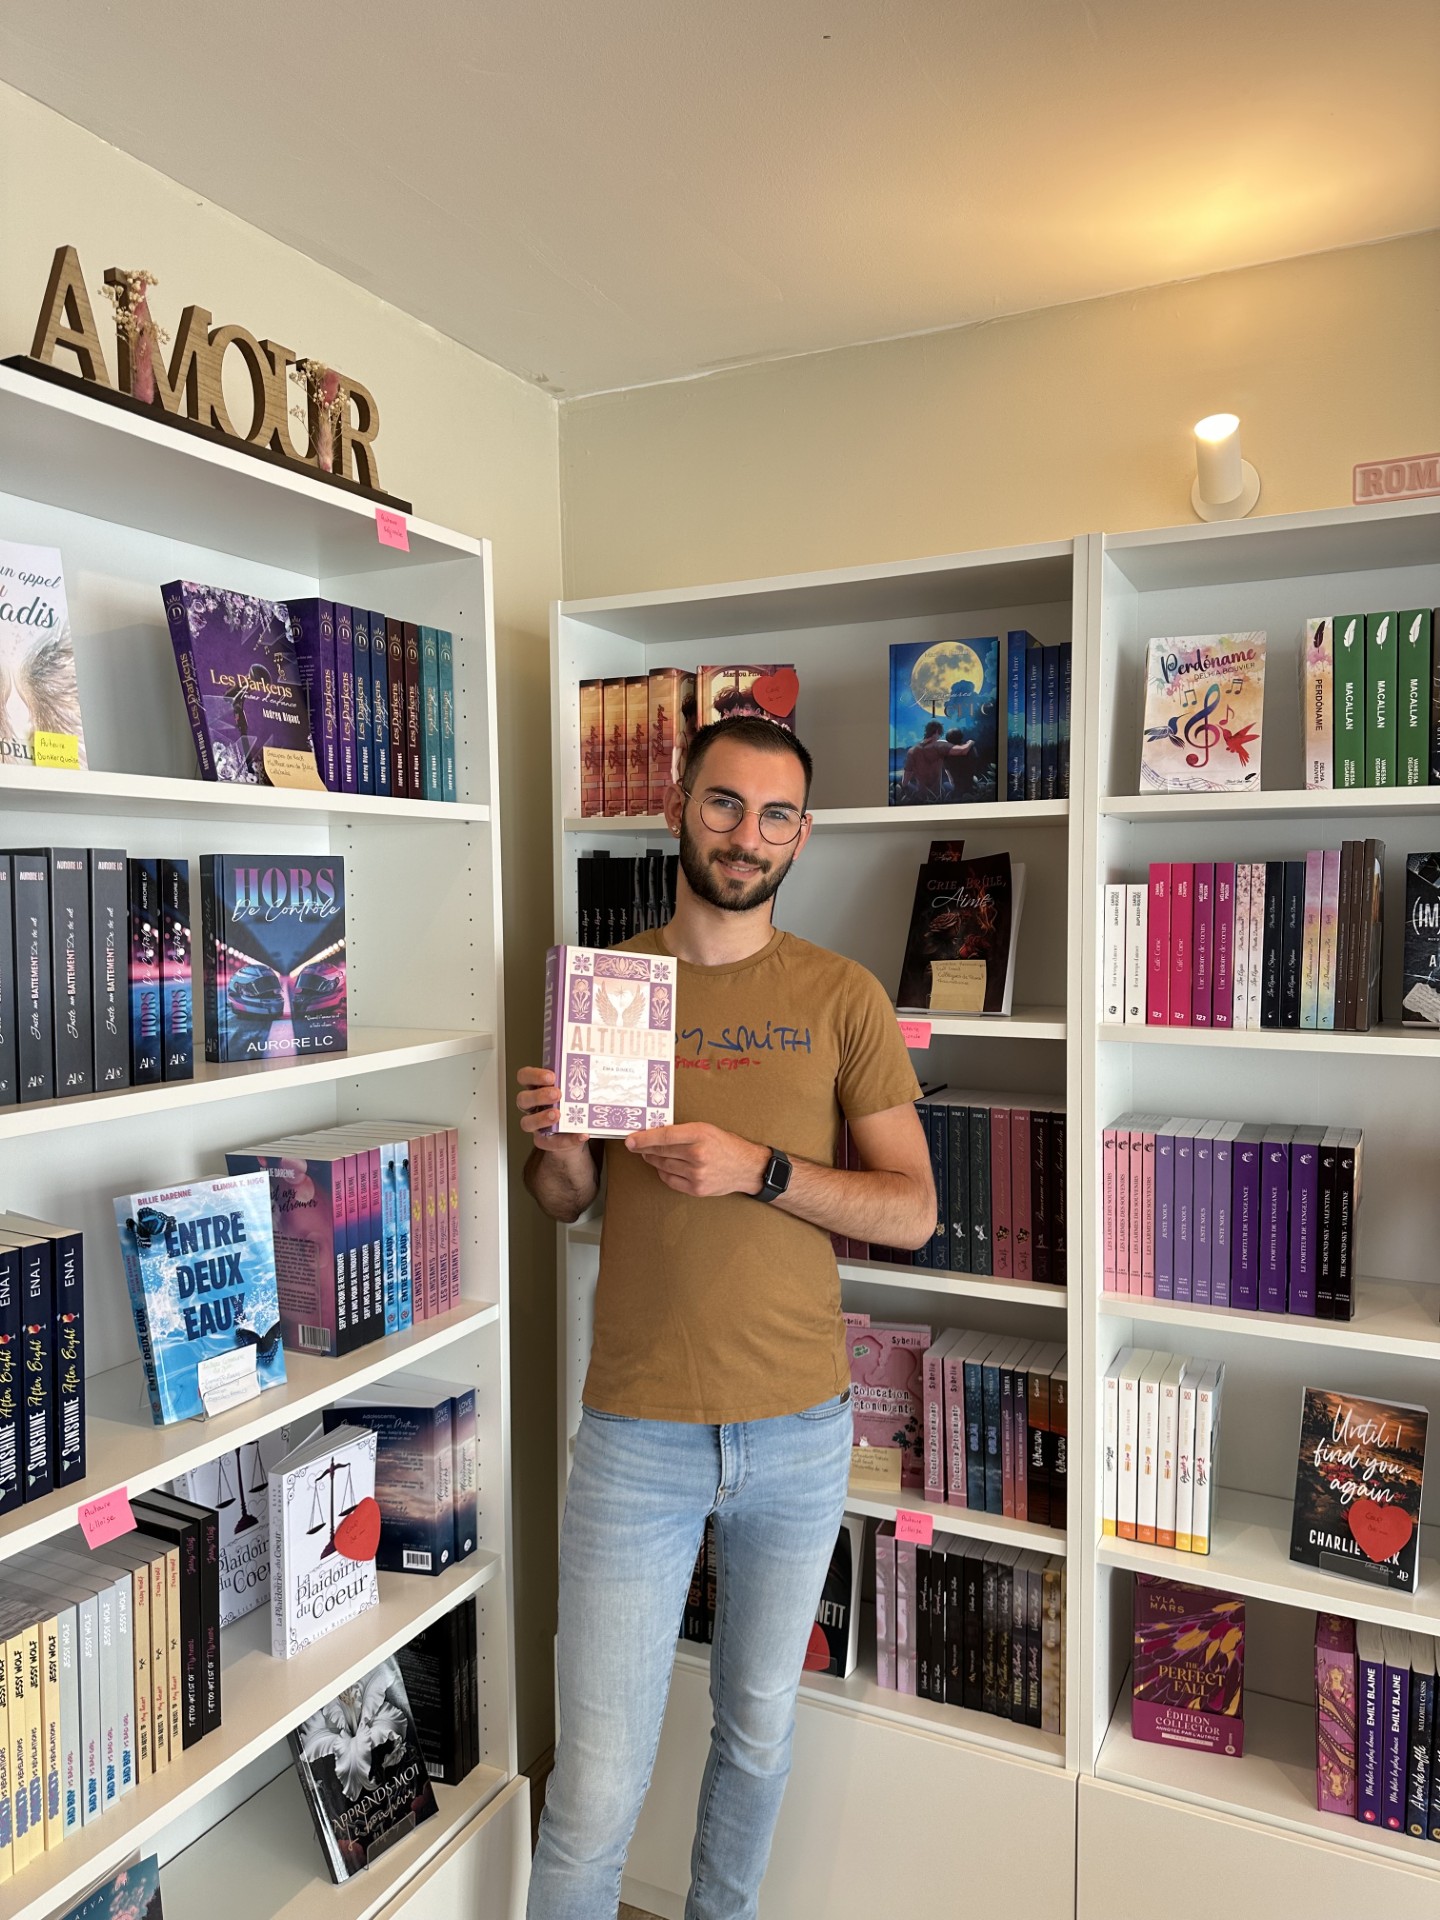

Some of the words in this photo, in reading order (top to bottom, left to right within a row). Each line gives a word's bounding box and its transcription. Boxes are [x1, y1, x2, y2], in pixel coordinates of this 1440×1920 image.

[29, 245, 388, 494] AMOUR
[18, 569, 61, 589] appel
[1160, 648, 1257, 684] Perdóname
[1222, 662, 1256, 676] BOUVIER
[210, 669, 236, 687] Les
[237, 674, 293, 698] Darkens
[1314, 679, 1323, 731] PERDÓNAME
[1345, 682, 1353, 730] MACALLAN
[1377, 680, 1385, 728] MACALLAN
[38, 871, 44, 881] LC
[142, 872, 147, 880] LC
[234, 867, 335, 908] HORS
[231, 898, 260, 922] De
[265, 898, 341, 923] Contrôle
[1153, 957, 1161, 971] Café
[1197, 954, 1206, 975] histoire
[30, 1012, 41, 1040] Juste
[141, 991, 156, 1037] HORS
[570, 1025, 668, 1059] ALTITUDE
[137, 1195, 159, 1206] BILLIE
[160, 1189, 192, 1202] DARENNE
[164, 1210, 246, 1259] ENTRE
[1242, 1223, 1248, 1231] DE
[64, 1248, 74, 1259] L
[386, 1236, 394, 1256] EAUX
[64, 1262, 75, 1287] ENA
[176, 1252, 244, 1299] DEUX
[1242, 1261, 1247, 1269] LE
[1270, 1262, 1276, 1270] LE
[414, 1262, 422, 1296] INSTANTS
[0, 1278, 11, 1306] ENA
[136, 1308, 148, 1333] EAUX
[183, 1293, 246, 1341] EAUX
[338, 1316, 346, 1330] SEPT
[60, 1328, 77, 1359] Eight
[140, 1335, 152, 1360] DEUX
[892, 1336, 920, 1346] Sybelia
[62, 1364, 77, 1393] After
[146, 1361, 156, 1392] ENTRE
[458, 1398, 473, 1410] LOVE
[853, 1385, 909, 1400] Colocation
[1331, 1405, 1389, 1449] Until
[1312, 1437, 1360, 1470] find
[1328, 1475, 1395, 1505] again
[274, 1531, 282, 1558] Coeur
[1309, 1529, 1360, 1555] CHARLIE
[297, 1574, 310, 1588] La
[297, 1560, 364, 1606] Plaidoirie
[274, 1573, 283, 1617] Plaidoirie
[297, 1603, 310, 1618] du
[312, 1574, 368, 1619] Coeur
[1150, 1595, 1175, 1604] LYLA
[1150, 1603, 1185, 1614] MARS
[14, 1650, 23, 1673] WOLF
[29, 1640, 37, 1663] WOLF
[30, 1666, 38, 1688] JESSY
[1158, 1664, 1226, 1687] PERFECT
[1185, 1662, 1199, 1670] THE
[15, 1676, 24, 1698] JESSY
[1174, 1680, 1209, 1697] FALL
[1367, 1668, 1375, 1699] BLAINE
[1155, 1717, 1220, 1736] COLLECTOR
[1166, 1708, 1210, 1726] ÉDITION
[1367, 1702, 1375, 1726] EMILY
[1156, 1725, 1180, 1734] ANNOTÉE
[1193, 1732, 1219, 1741] L'AUTRICE
[1365, 1749, 1377, 1763] plus
[331, 1763, 420, 1833] APPRENDS-MOI
